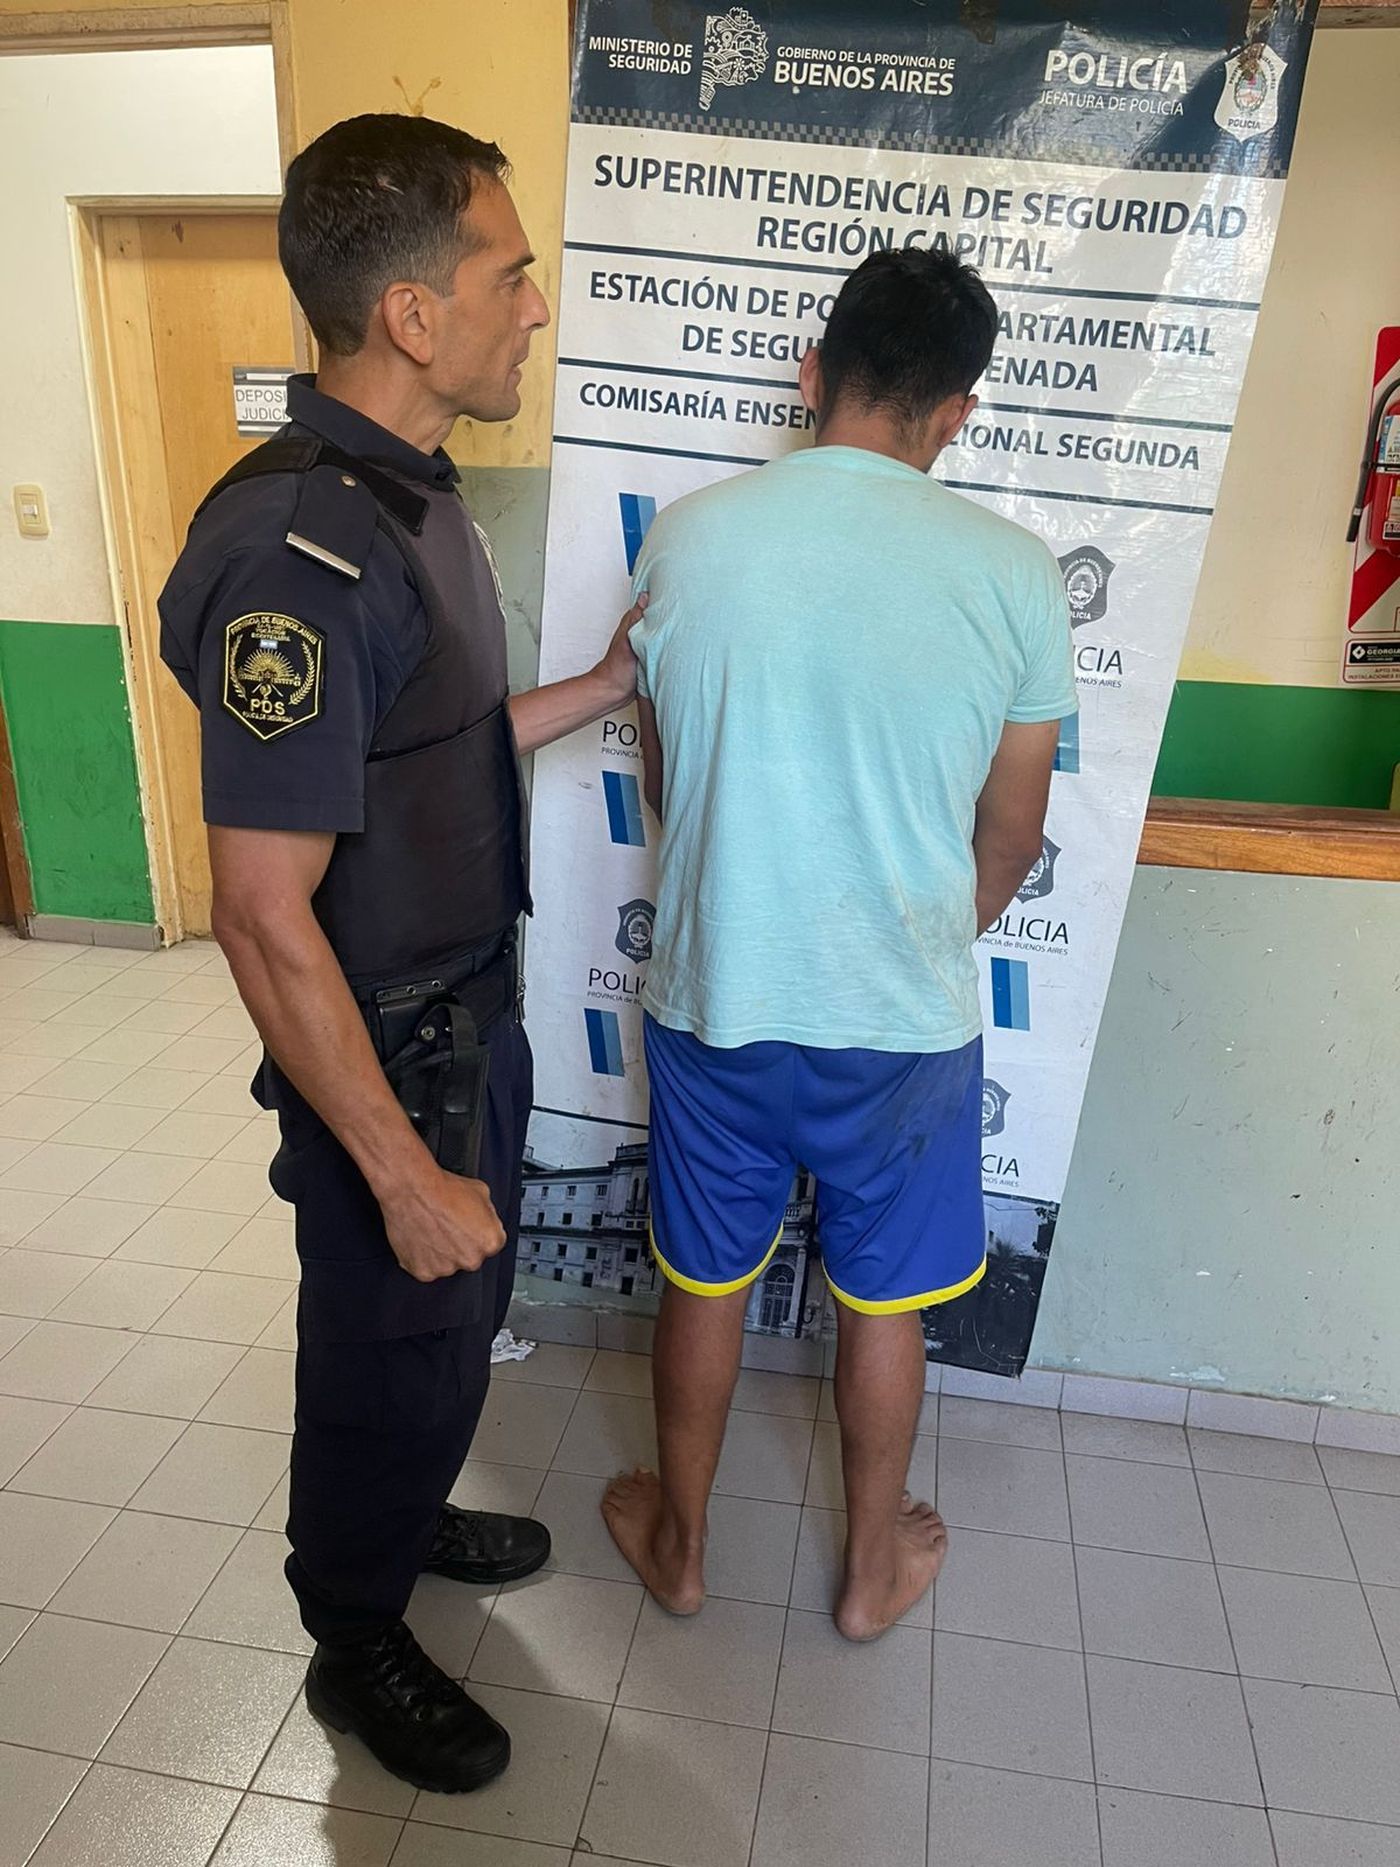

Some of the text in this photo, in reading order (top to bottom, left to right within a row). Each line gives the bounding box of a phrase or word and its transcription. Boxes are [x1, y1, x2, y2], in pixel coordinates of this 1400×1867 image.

[589, 36, 693, 58] MINISTERIO DE
[777, 46, 957, 70] GOBIERNO DE LA PROVINCIA DE
[608, 54, 691, 75] SEGURIDAD
[1044, 50, 1188, 94] POLICÍA
[774, 60, 954, 96] BUENOS AIRES
[1039, 90, 1185, 116] JEFATURA DE POLICÍA
[1227, 118, 1261, 129] POLICIA
[594, 155, 1248, 240] SUPERINTENDENCIA DE SEGURIDAD
[757, 217, 895, 256] REGIÓN
[590, 271, 1216, 356] ESTACIÓN DE PO ARTAMENTAL
[682, 324, 1098, 392] DE SEGU ENADA
[235, 389, 287, 403] DEPOSI
[579, 382, 1200, 470] COMISARÍA ENSEN IONAL SEGUNDA
[1070, 610, 1091, 620] LICIA
[1073, 645, 1122, 675] CIA
[1075, 677, 1098, 686] ENOS
[250, 698, 286, 716] PDS
[603, 720, 642, 748] PO
[1014, 942, 1046, 953] BUENOS
[1046, 946, 1069, 956] AIRES
[588, 967, 647, 995] POLI
[981, 1154, 1020, 1178] CIA
